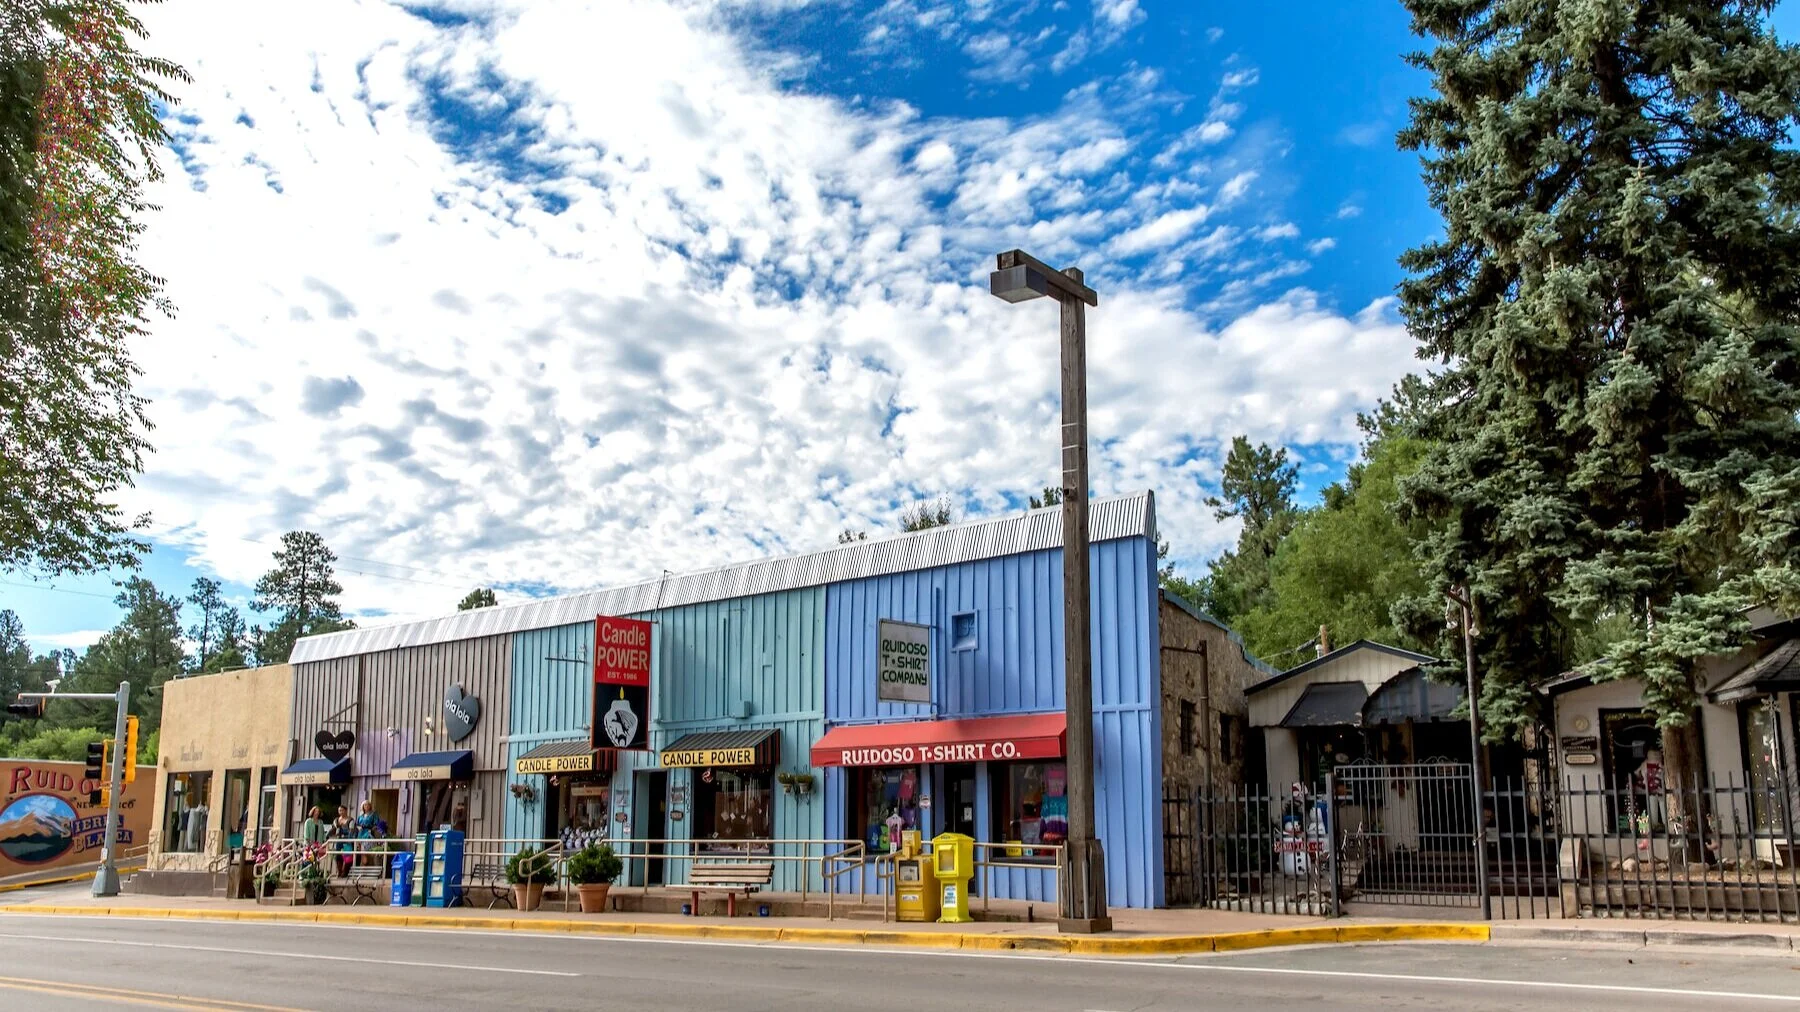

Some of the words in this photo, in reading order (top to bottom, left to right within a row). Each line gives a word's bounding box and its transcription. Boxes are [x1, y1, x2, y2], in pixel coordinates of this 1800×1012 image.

[602, 622, 646, 646] Candle
[882, 639, 927, 656] RUIDOSO
[597, 646, 648, 671] POWER
[882, 670, 927, 686] COMPANY
[445, 699, 457, 713] ola
[455, 704, 470, 724] lola
[323, 742, 334, 750] ola
[336, 742, 349, 750] lola
[841, 747, 914, 765] RUIDOSO
[991, 741, 1021, 758] CO.
[518, 760, 551, 772] CANDLE
[557, 757, 590, 769] POWER
[663, 752, 704, 765] CANDLE
[711, 750, 751, 763] POWER
[9, 766, 126, 796] RUIDO
[408, 770, 419, 778] ola
[421, 769, 432, 778] lola
[73, 830, 131, 853] BLACA
